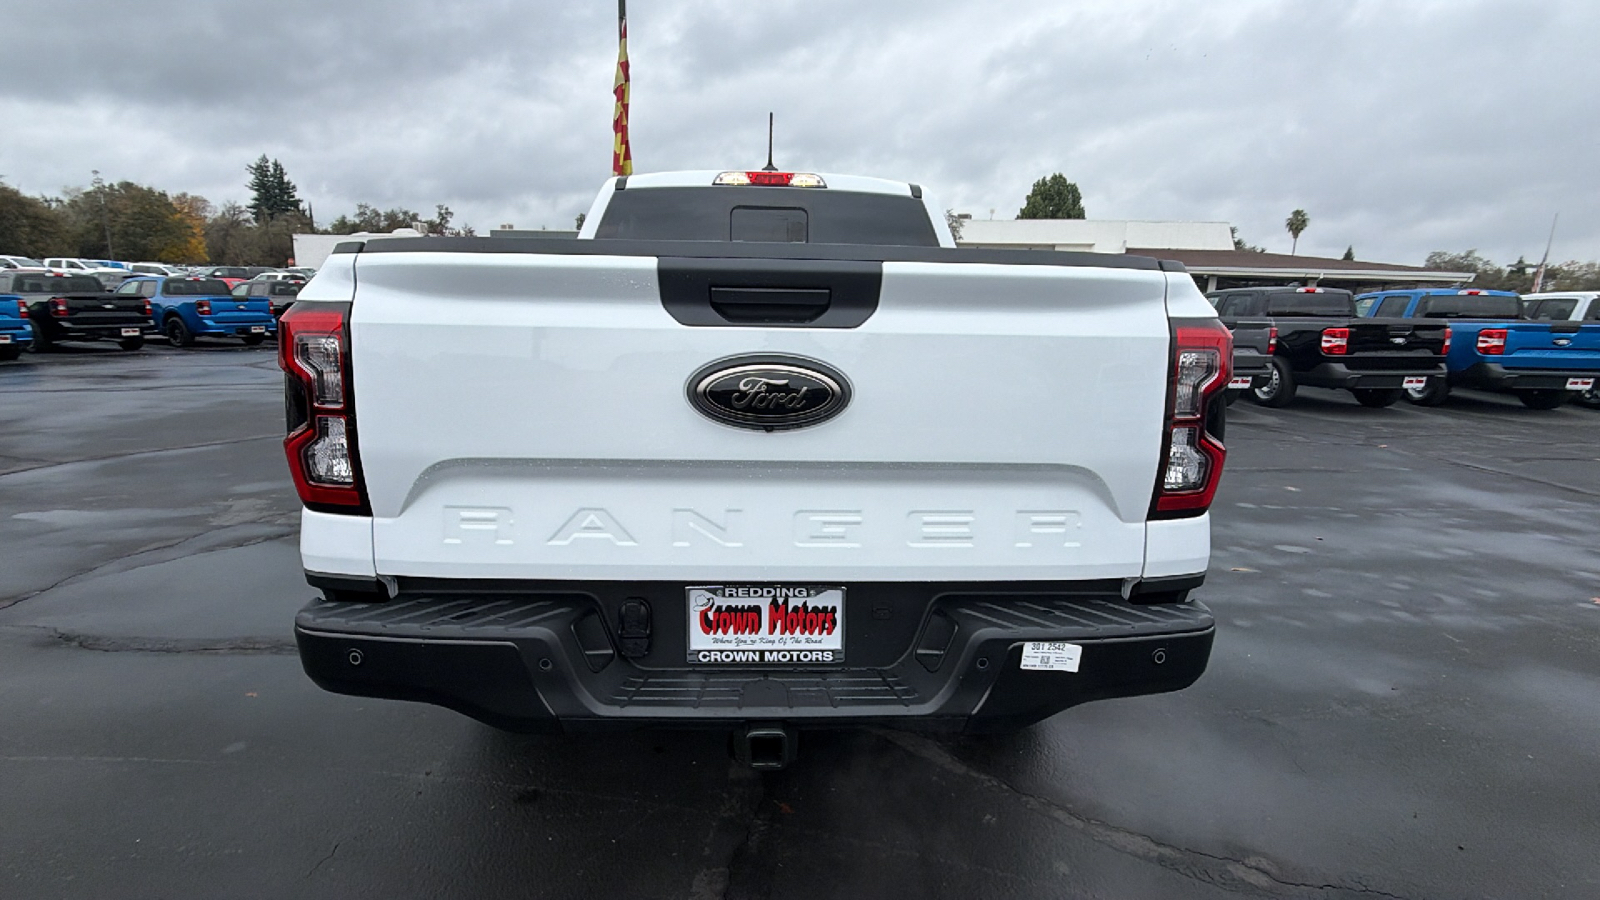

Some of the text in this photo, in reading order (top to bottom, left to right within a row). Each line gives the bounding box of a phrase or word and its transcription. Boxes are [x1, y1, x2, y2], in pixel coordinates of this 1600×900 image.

[731, 376, 808, 409] Ford
[442, 505, 1082, 547] RANGER
[724, 587, 807, 597] REDDING
[699, 600, 836, 635] Crown Motors
[734, 637, 757, 645] You're
[759, 637, 775, 645] King
[778, 637, 788, 645] Of
[698, 651, 834, 662] CROWN MOTORS
